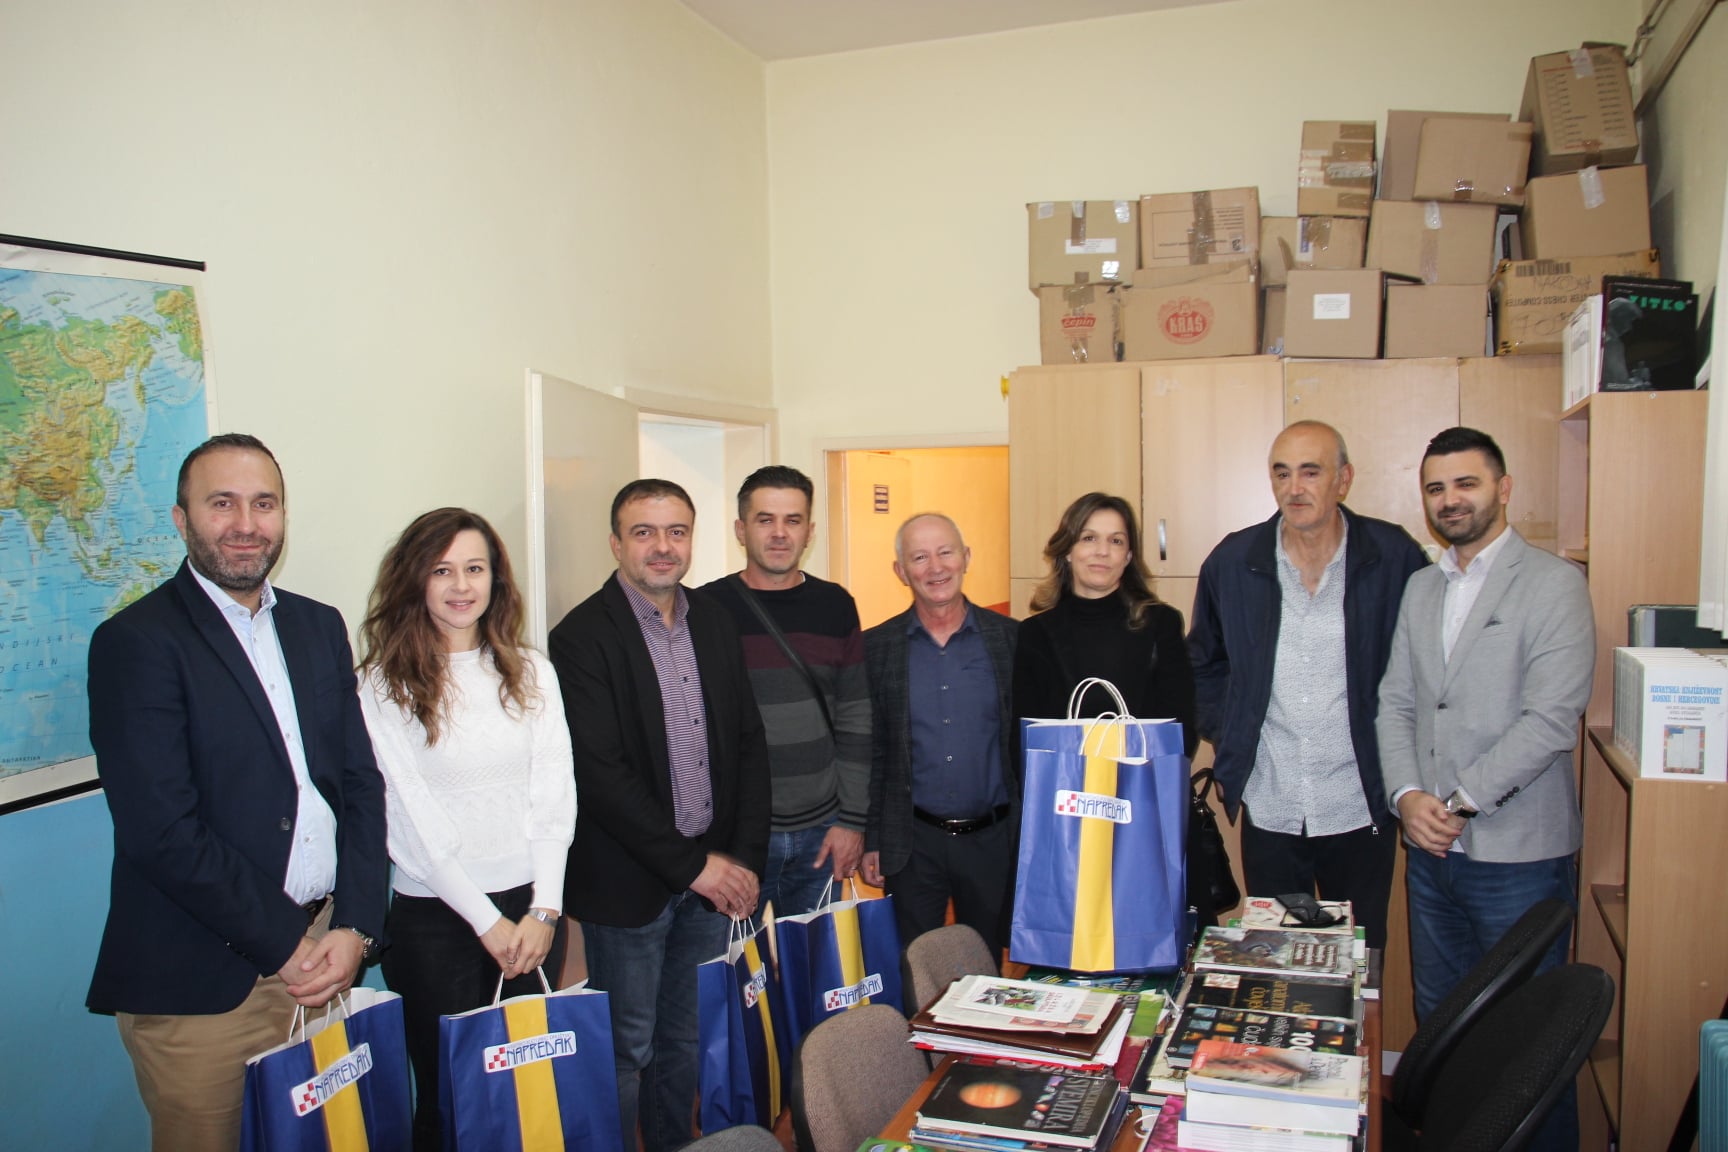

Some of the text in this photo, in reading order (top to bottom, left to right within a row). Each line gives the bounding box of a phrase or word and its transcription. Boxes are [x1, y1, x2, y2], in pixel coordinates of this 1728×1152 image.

[1076, 799, 1129, 821] NAPREDAK
[1239, 1025, 1266, 1046] čud
[506, 1036, 574, 1067] NAPREDAK
[315, 1049, 371, 1103] NAPREDAK
[1042, 1078, 1092, 1131] SVEMIRA
